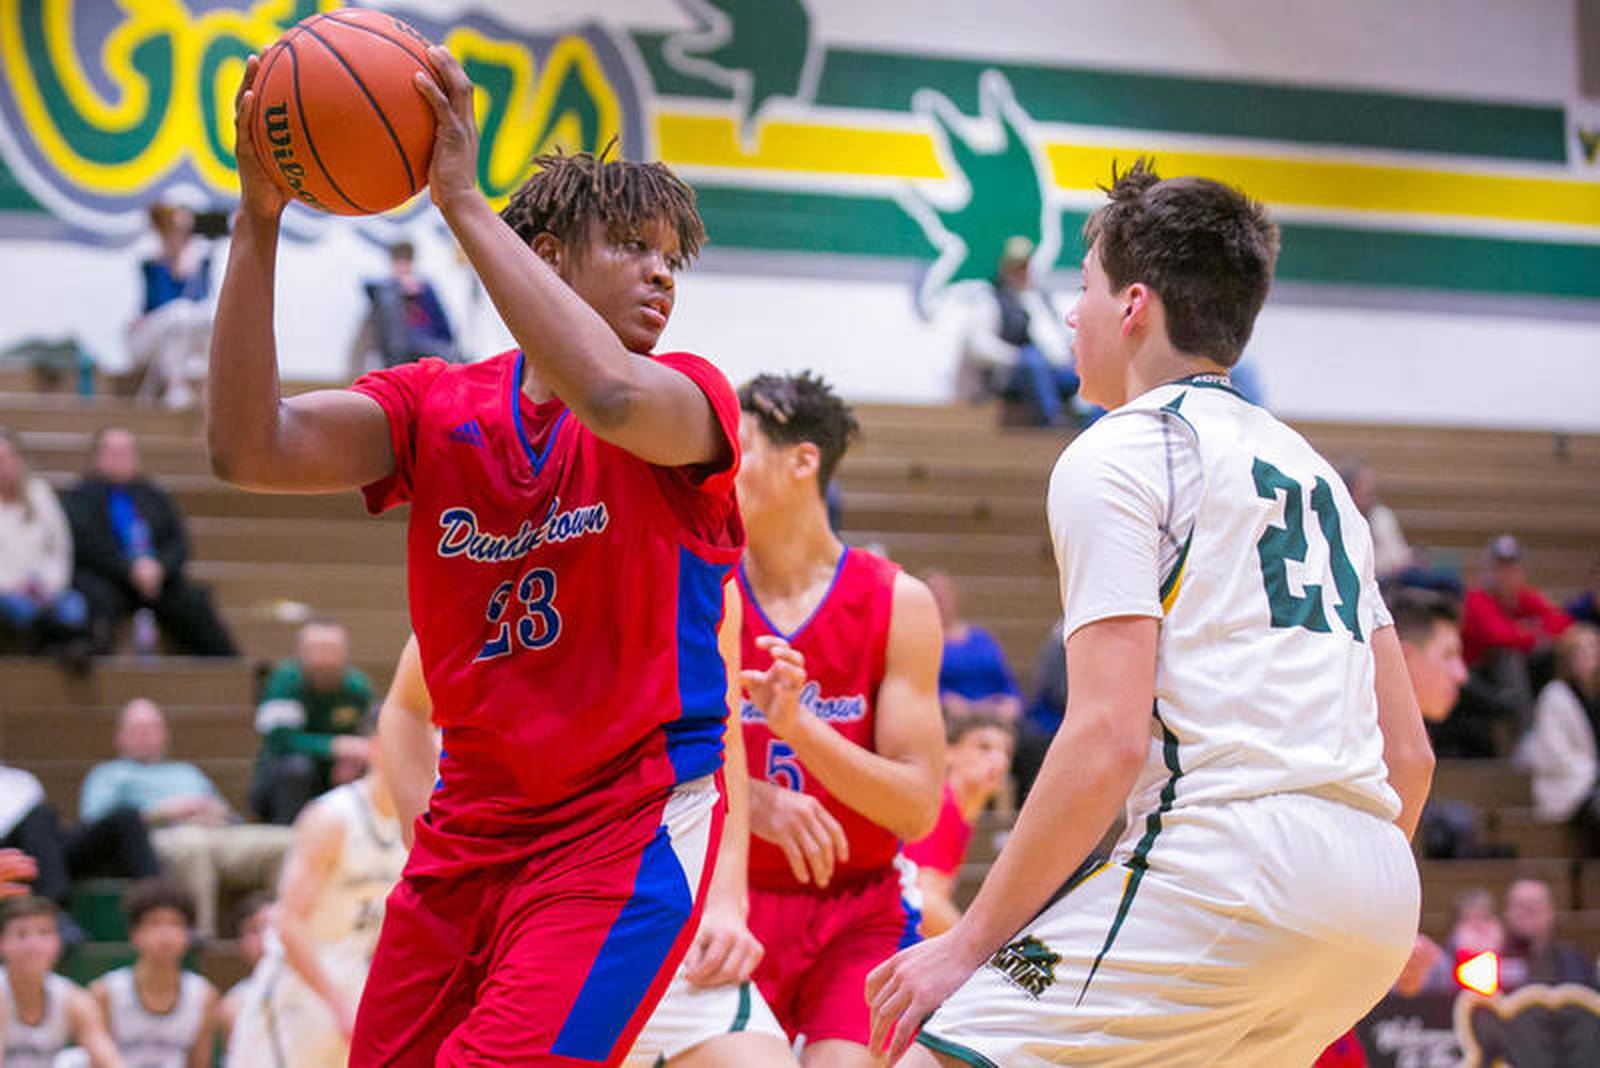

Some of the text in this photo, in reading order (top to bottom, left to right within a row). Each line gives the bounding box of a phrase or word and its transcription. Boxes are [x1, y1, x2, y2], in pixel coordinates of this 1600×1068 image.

[1251, 455, 1366, 643] 21
[470, 566, 562, 664] 23
[765, 738, 804, 793] 5
